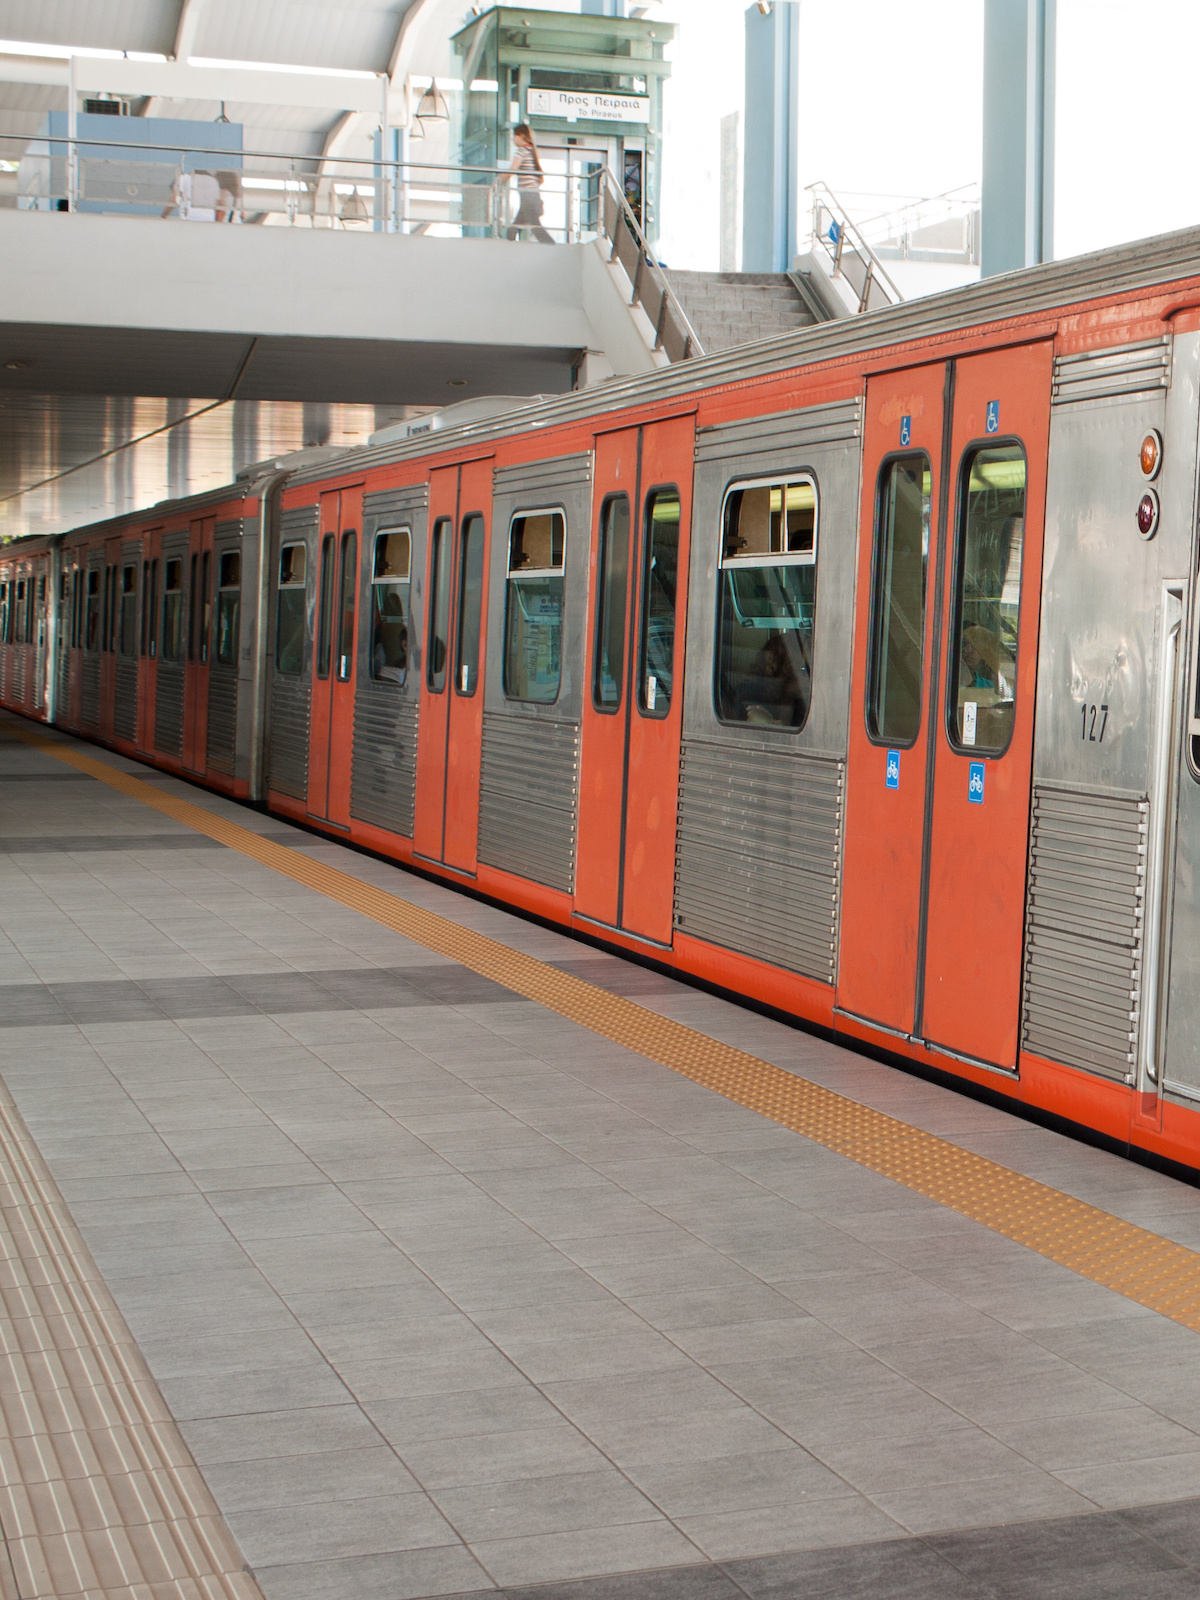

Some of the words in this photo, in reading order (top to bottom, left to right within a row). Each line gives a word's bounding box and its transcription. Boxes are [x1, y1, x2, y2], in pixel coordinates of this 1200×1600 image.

[559, 93, 589, 107] Προς
[595, 96, 641, 109] Πειραιά
[578, 108, 588, 116] To
[591, 109, 623, 119] Piraeus
[1081, 703, 1109, 743] 127
